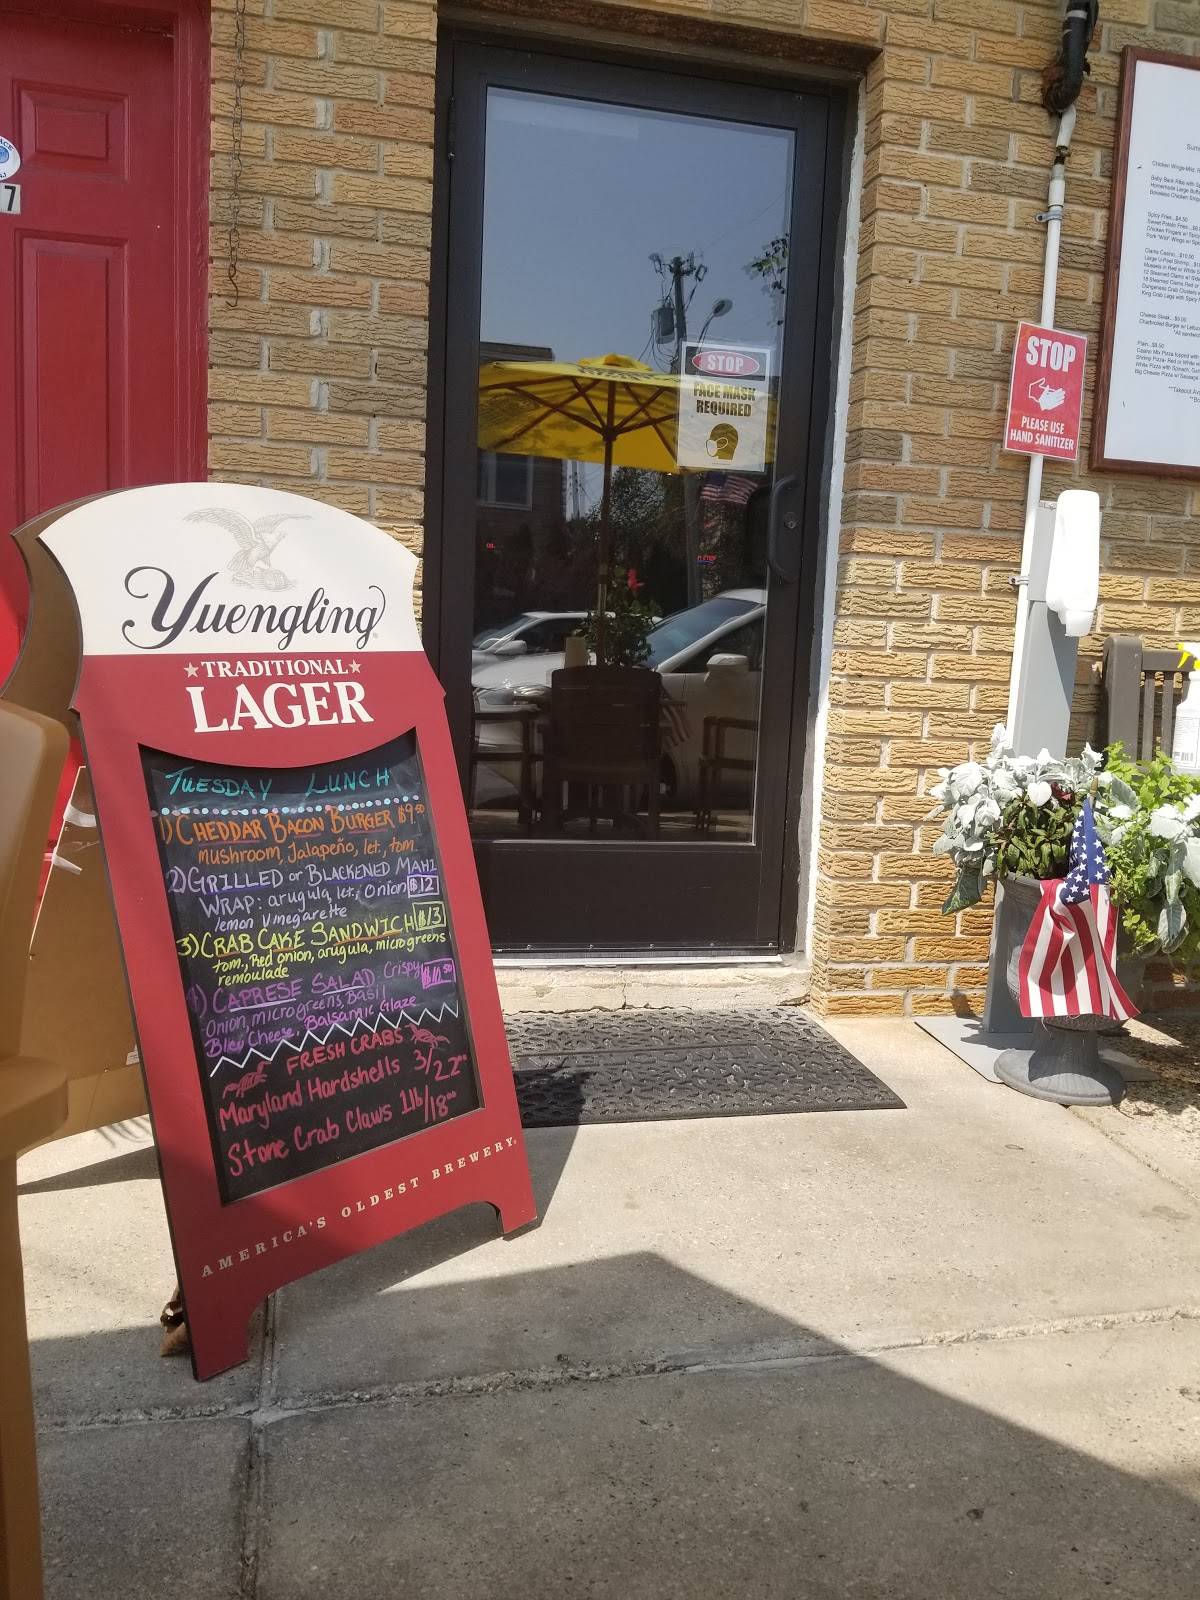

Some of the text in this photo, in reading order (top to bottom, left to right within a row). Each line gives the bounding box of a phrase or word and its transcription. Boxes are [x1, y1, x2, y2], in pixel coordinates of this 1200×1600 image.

[707, 356, 744, 373] STOP
[1026, 335, 1076, 372] STOP
[693, 382, 756, 401] FACE MASK
[696, 400, 752, 417] REQUIRED
[1010, 428, 1074, 451] HAND SANITIZER
[1022, 415, 1065, 435] PLEASE USE
[121, 565, 386, 651] Yuengling
[201, 659, 349, 678] TRADITIONAL
[185, 681, 374, 733] LAGER
[164, 766, 390, 801] TUESDAY LUNCH
[264, 812, 325, 844] BACON
[328, 806, 396, 834] BURGER
[197, 846, 284, 865] mushroom,
[288, 871, 304, 882] or
[305, 861, 391, 887] BLACKENED
[364, 879, 408, 899] Onion
[409, 877, 435, 894] $12
[214, 916, 255, 933] lemon
[257, 927, 306, 951] CAKE
[309, 913, 415, 947] SANDWICH
[417, 905, 443, 929] $13
[249, 949, 273, 968] Red
[217, 966, 290, 986] remoulade
[310, 967, 376, 995] SALAD
[383, 960, 421, 981] Crispy
[304, 1006, 375, 1031] Balsamic
[379, 995, 418, 1013] Glaze
[286, 1027, 405, 1076] FRESH CRABS
[218, 1079, 304, 1131] Maryland
[306, 1054, 402, 1103] Hardshells
[227, 1138, 290, 1177] Stone
[293, 1116, 341, 1153] Crab
[344, 1102, 394, 1134] Claws
[201, 1215, 328, 1279] AMERICA'S
[340, 1176, 421, 1219] OLDEST
